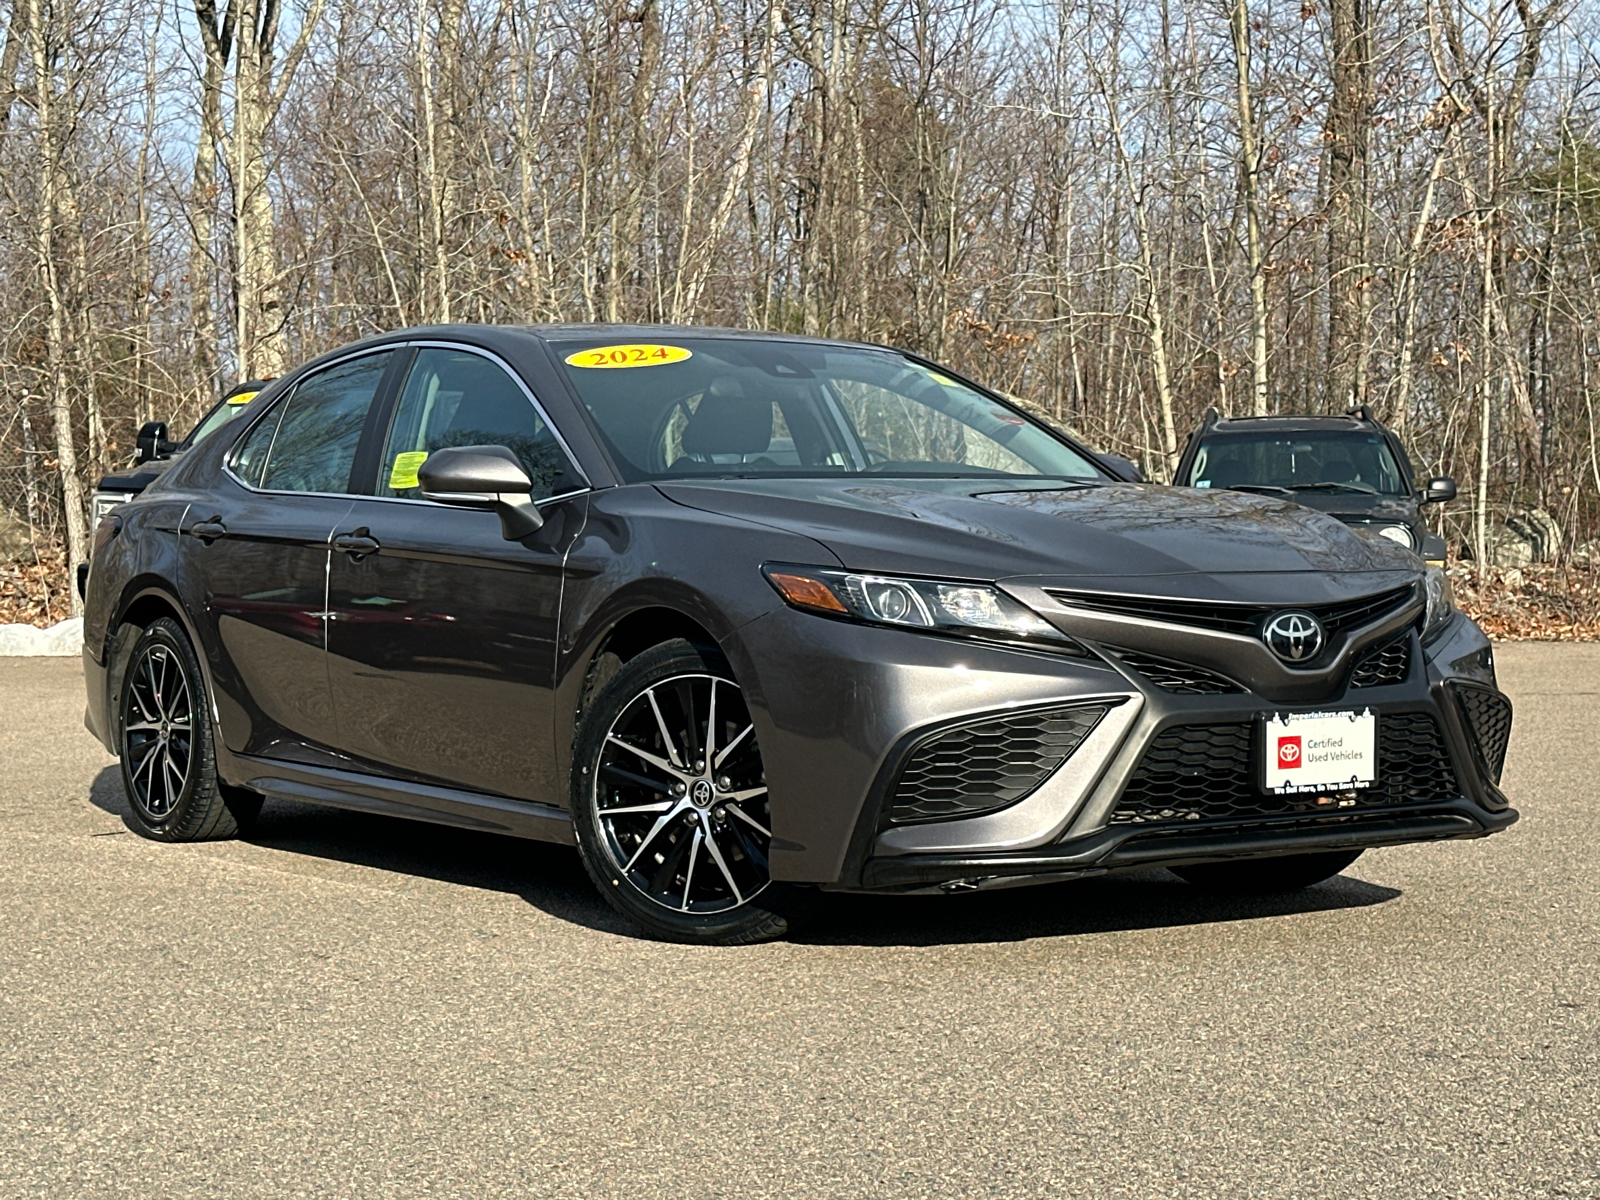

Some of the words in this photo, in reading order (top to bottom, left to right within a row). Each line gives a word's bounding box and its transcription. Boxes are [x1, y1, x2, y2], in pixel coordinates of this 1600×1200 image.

[590, 348, 669, 365] 2024
[1308, 737, 1343, 749] Certified
[1308, 752, 1328, 762] Used
[1330, 750, 1363, 761] Vehicles
[1286, 786, 1297, 794] Sell
[1299, 785, 1316, 793] More,
[1317, 784, 1325, 792] So
[1326, 783, 1338, 791] You
[1339, 782, 1353, 790] Save
[1354, 781, 1370, 789] More
